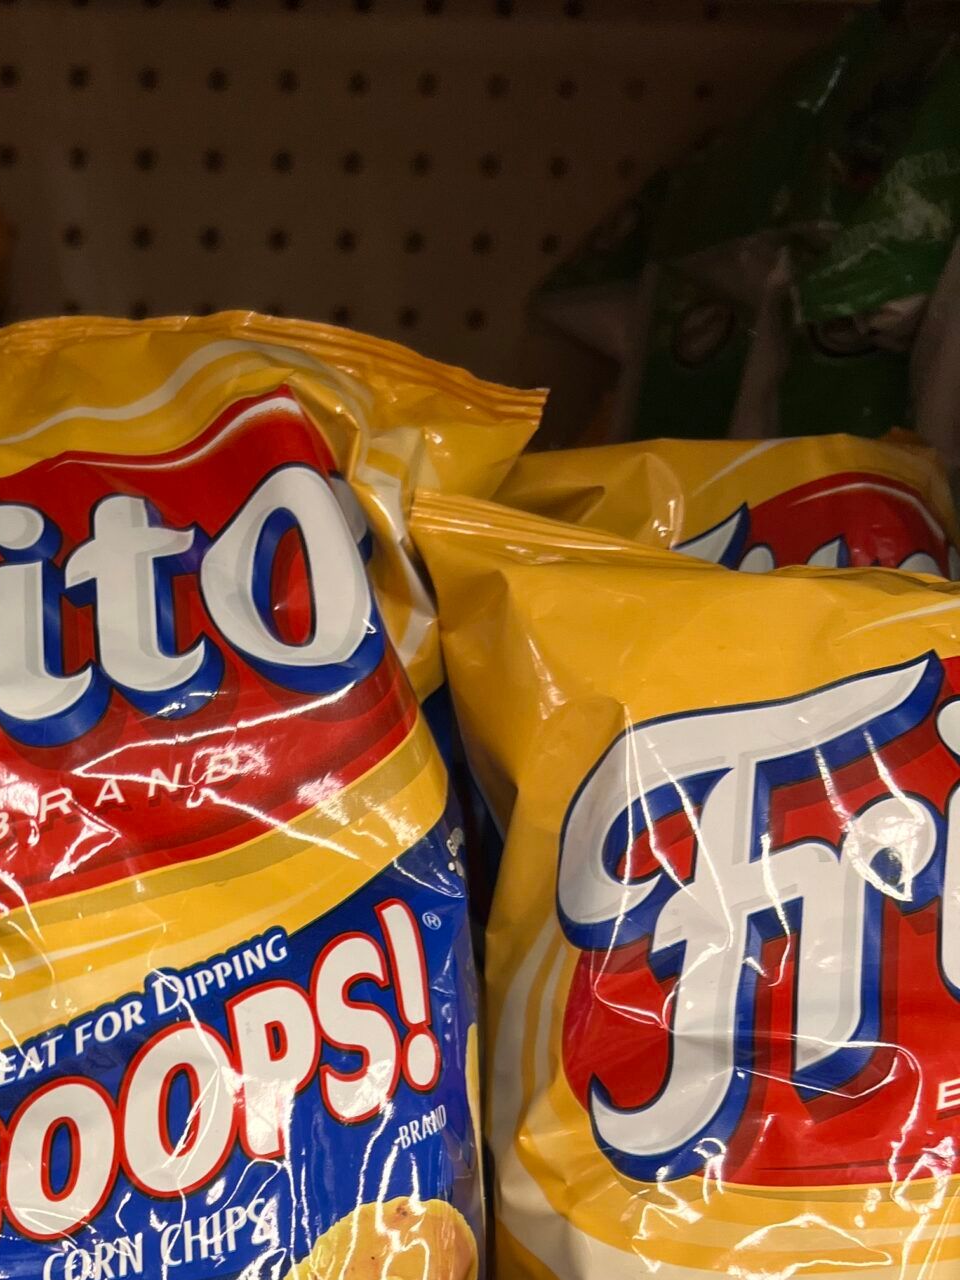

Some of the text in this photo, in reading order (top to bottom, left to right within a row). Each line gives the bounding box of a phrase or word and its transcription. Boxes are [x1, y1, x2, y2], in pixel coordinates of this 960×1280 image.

[74, 1000, 146, 1054] FOR
[151, 933, 288, 1016] DIPPING
[160, 1198, 276, 1268] CHIPS
